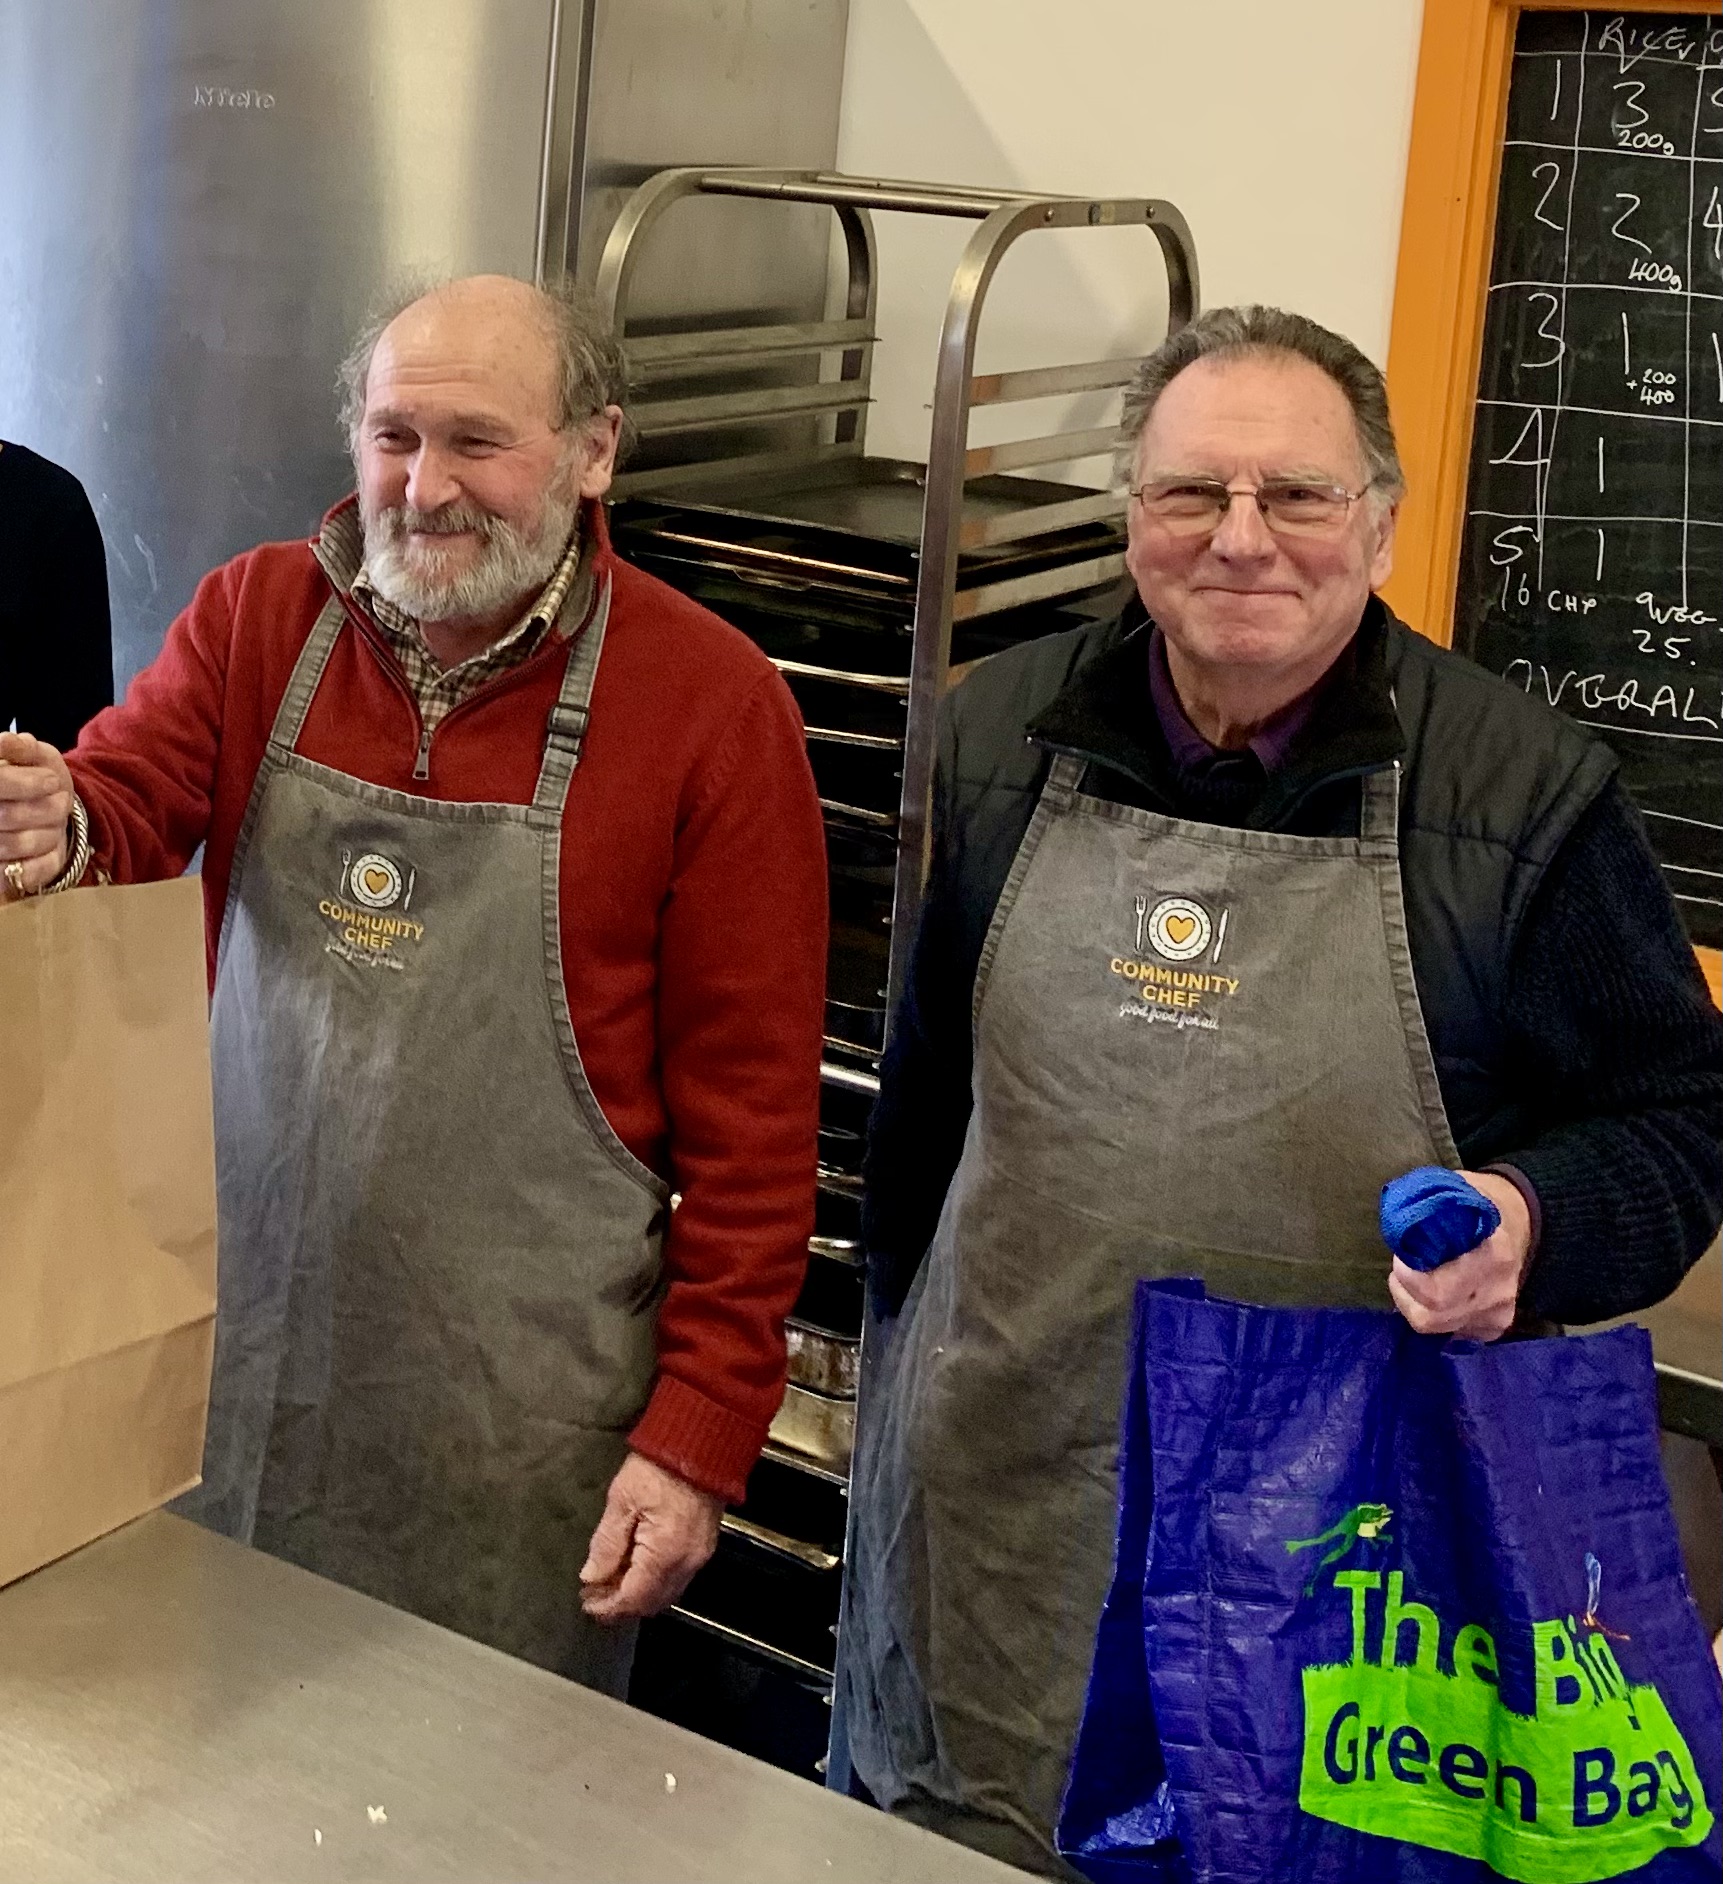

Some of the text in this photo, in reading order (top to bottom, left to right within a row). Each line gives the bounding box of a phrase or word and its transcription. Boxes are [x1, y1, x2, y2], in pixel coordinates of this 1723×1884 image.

[1550, 59, 1562, 120] 1
[1612, 81, 1650, 129] 3
[1531, 162, 1564, 231] 2
[1611, 193, 1653, 254] 2
[1520, 292, 1566, 368] 3
[1642, 368, 1677, 385] 200
[318, 900, 425, 941] COMMUNITY
[344, 927, 394, 950] CHEF
[1110, 957, 1240, 995] COMMUNITY
[1142, 984, 1202, 1008] CHEF
[1334, 1570, 1500, 1686] The
[1324, 1701, 1694, 1831] Green Bag
